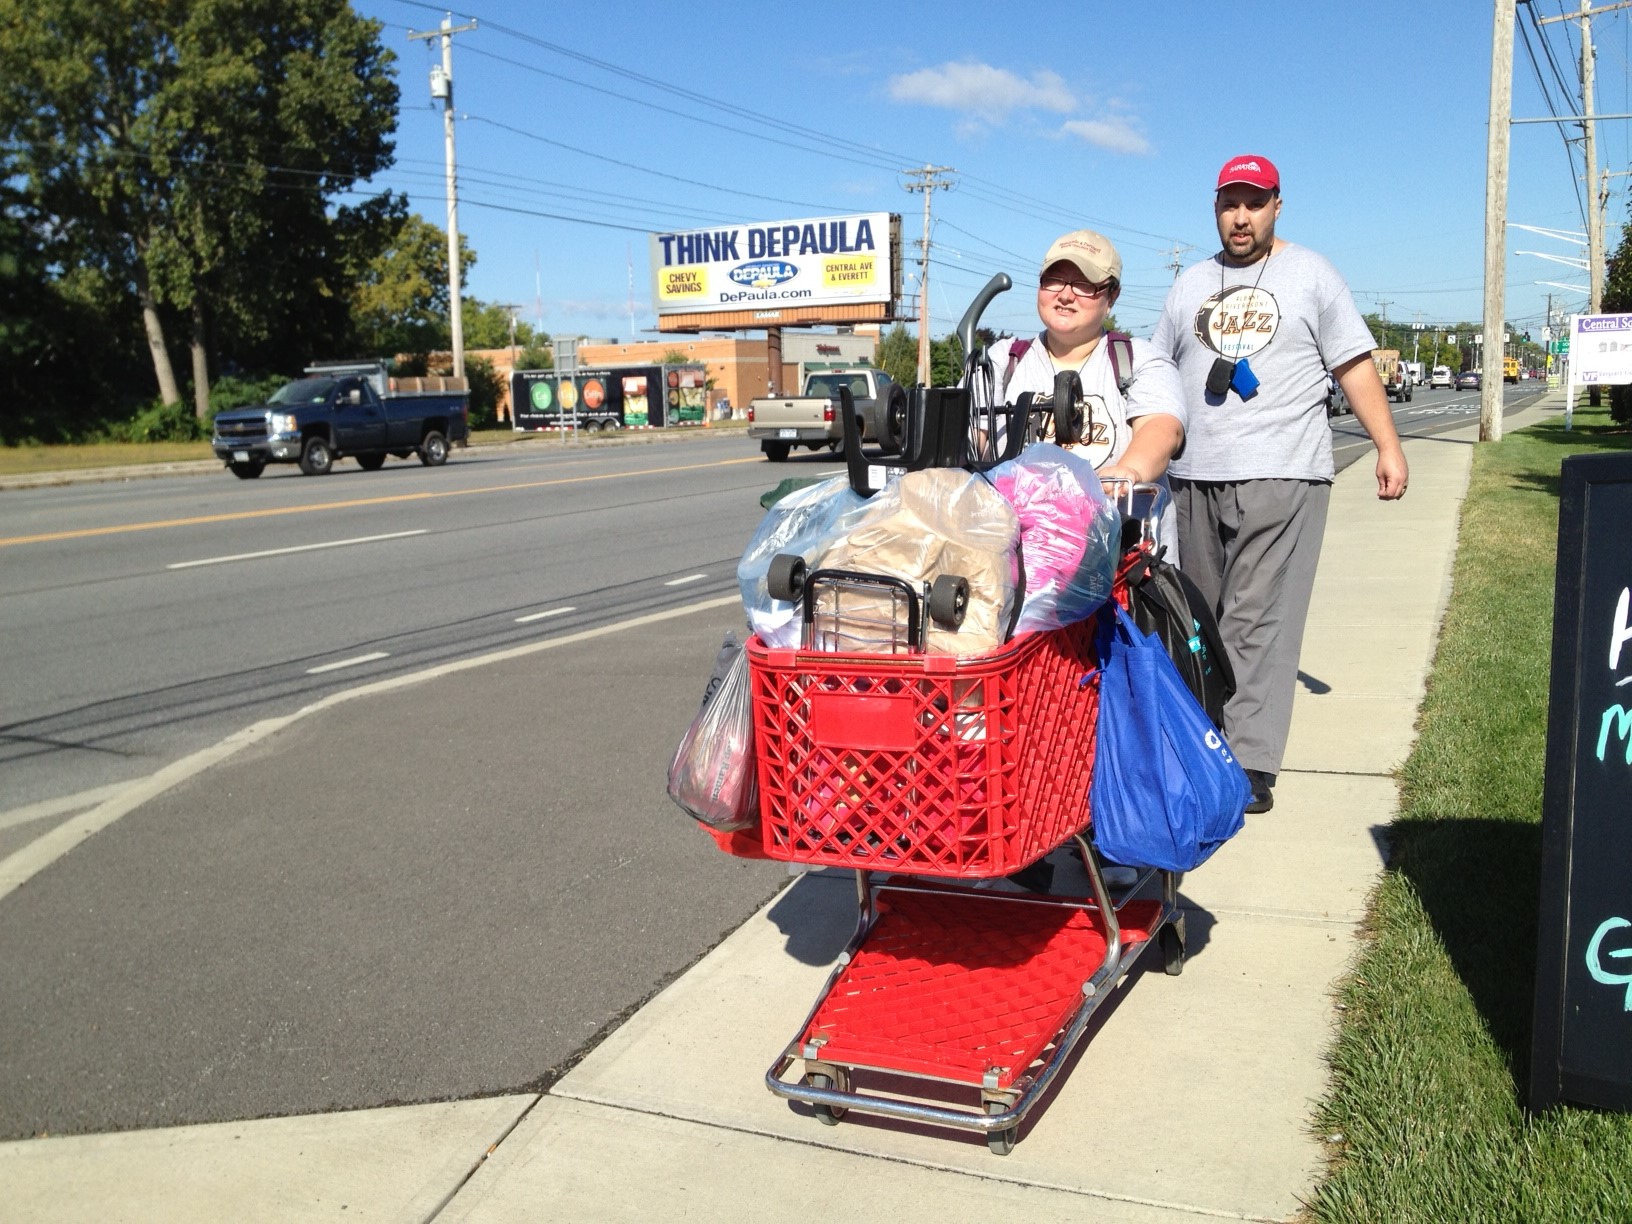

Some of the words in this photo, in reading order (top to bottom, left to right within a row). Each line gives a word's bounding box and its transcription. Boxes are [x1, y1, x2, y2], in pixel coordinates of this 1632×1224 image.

[658, 230, 740, 266] THINK
[748, 219, 875, 259] DEPAULA
[733, 265, 794, 281] DEPAULA
[826, 263, 857, 273] CENTRAL
[860, 262, 873, 271] AVE
[669, 272, 697, 284] CHEVY
[831, 273, 837, 282] &
[838, 272, 869, 281] EVERETT
[665, 282, 703, 294] SAVINGS
[719, 288, 812, 303] DePaula.com
[1213, 310, 1274, 335] JAZZ
[1582, 317, 1619, 330] Central
